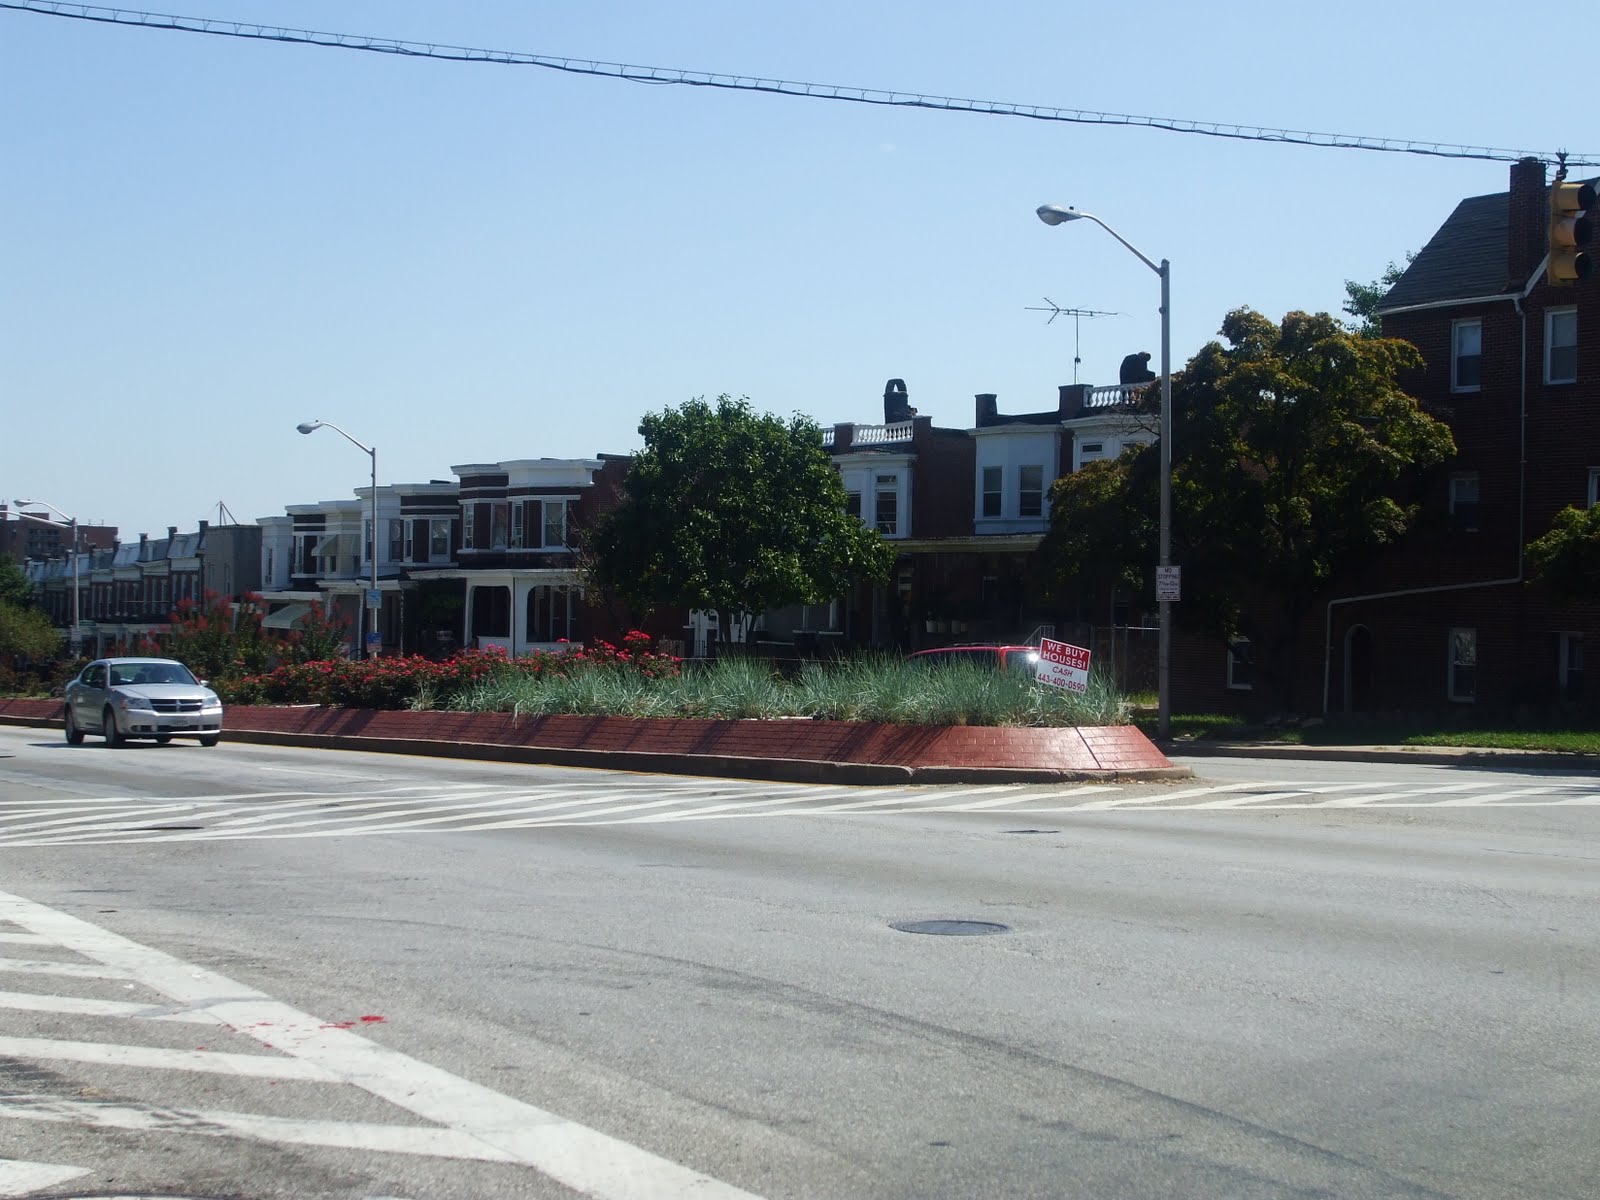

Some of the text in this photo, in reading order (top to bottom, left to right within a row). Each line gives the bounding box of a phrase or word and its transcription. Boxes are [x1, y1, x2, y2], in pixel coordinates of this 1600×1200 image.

[1047, 642, 1085, 659] WE BUY
[1043, 651, 1086, 669] HOUSES!
[1052, 666, 1074, 677] CASH
